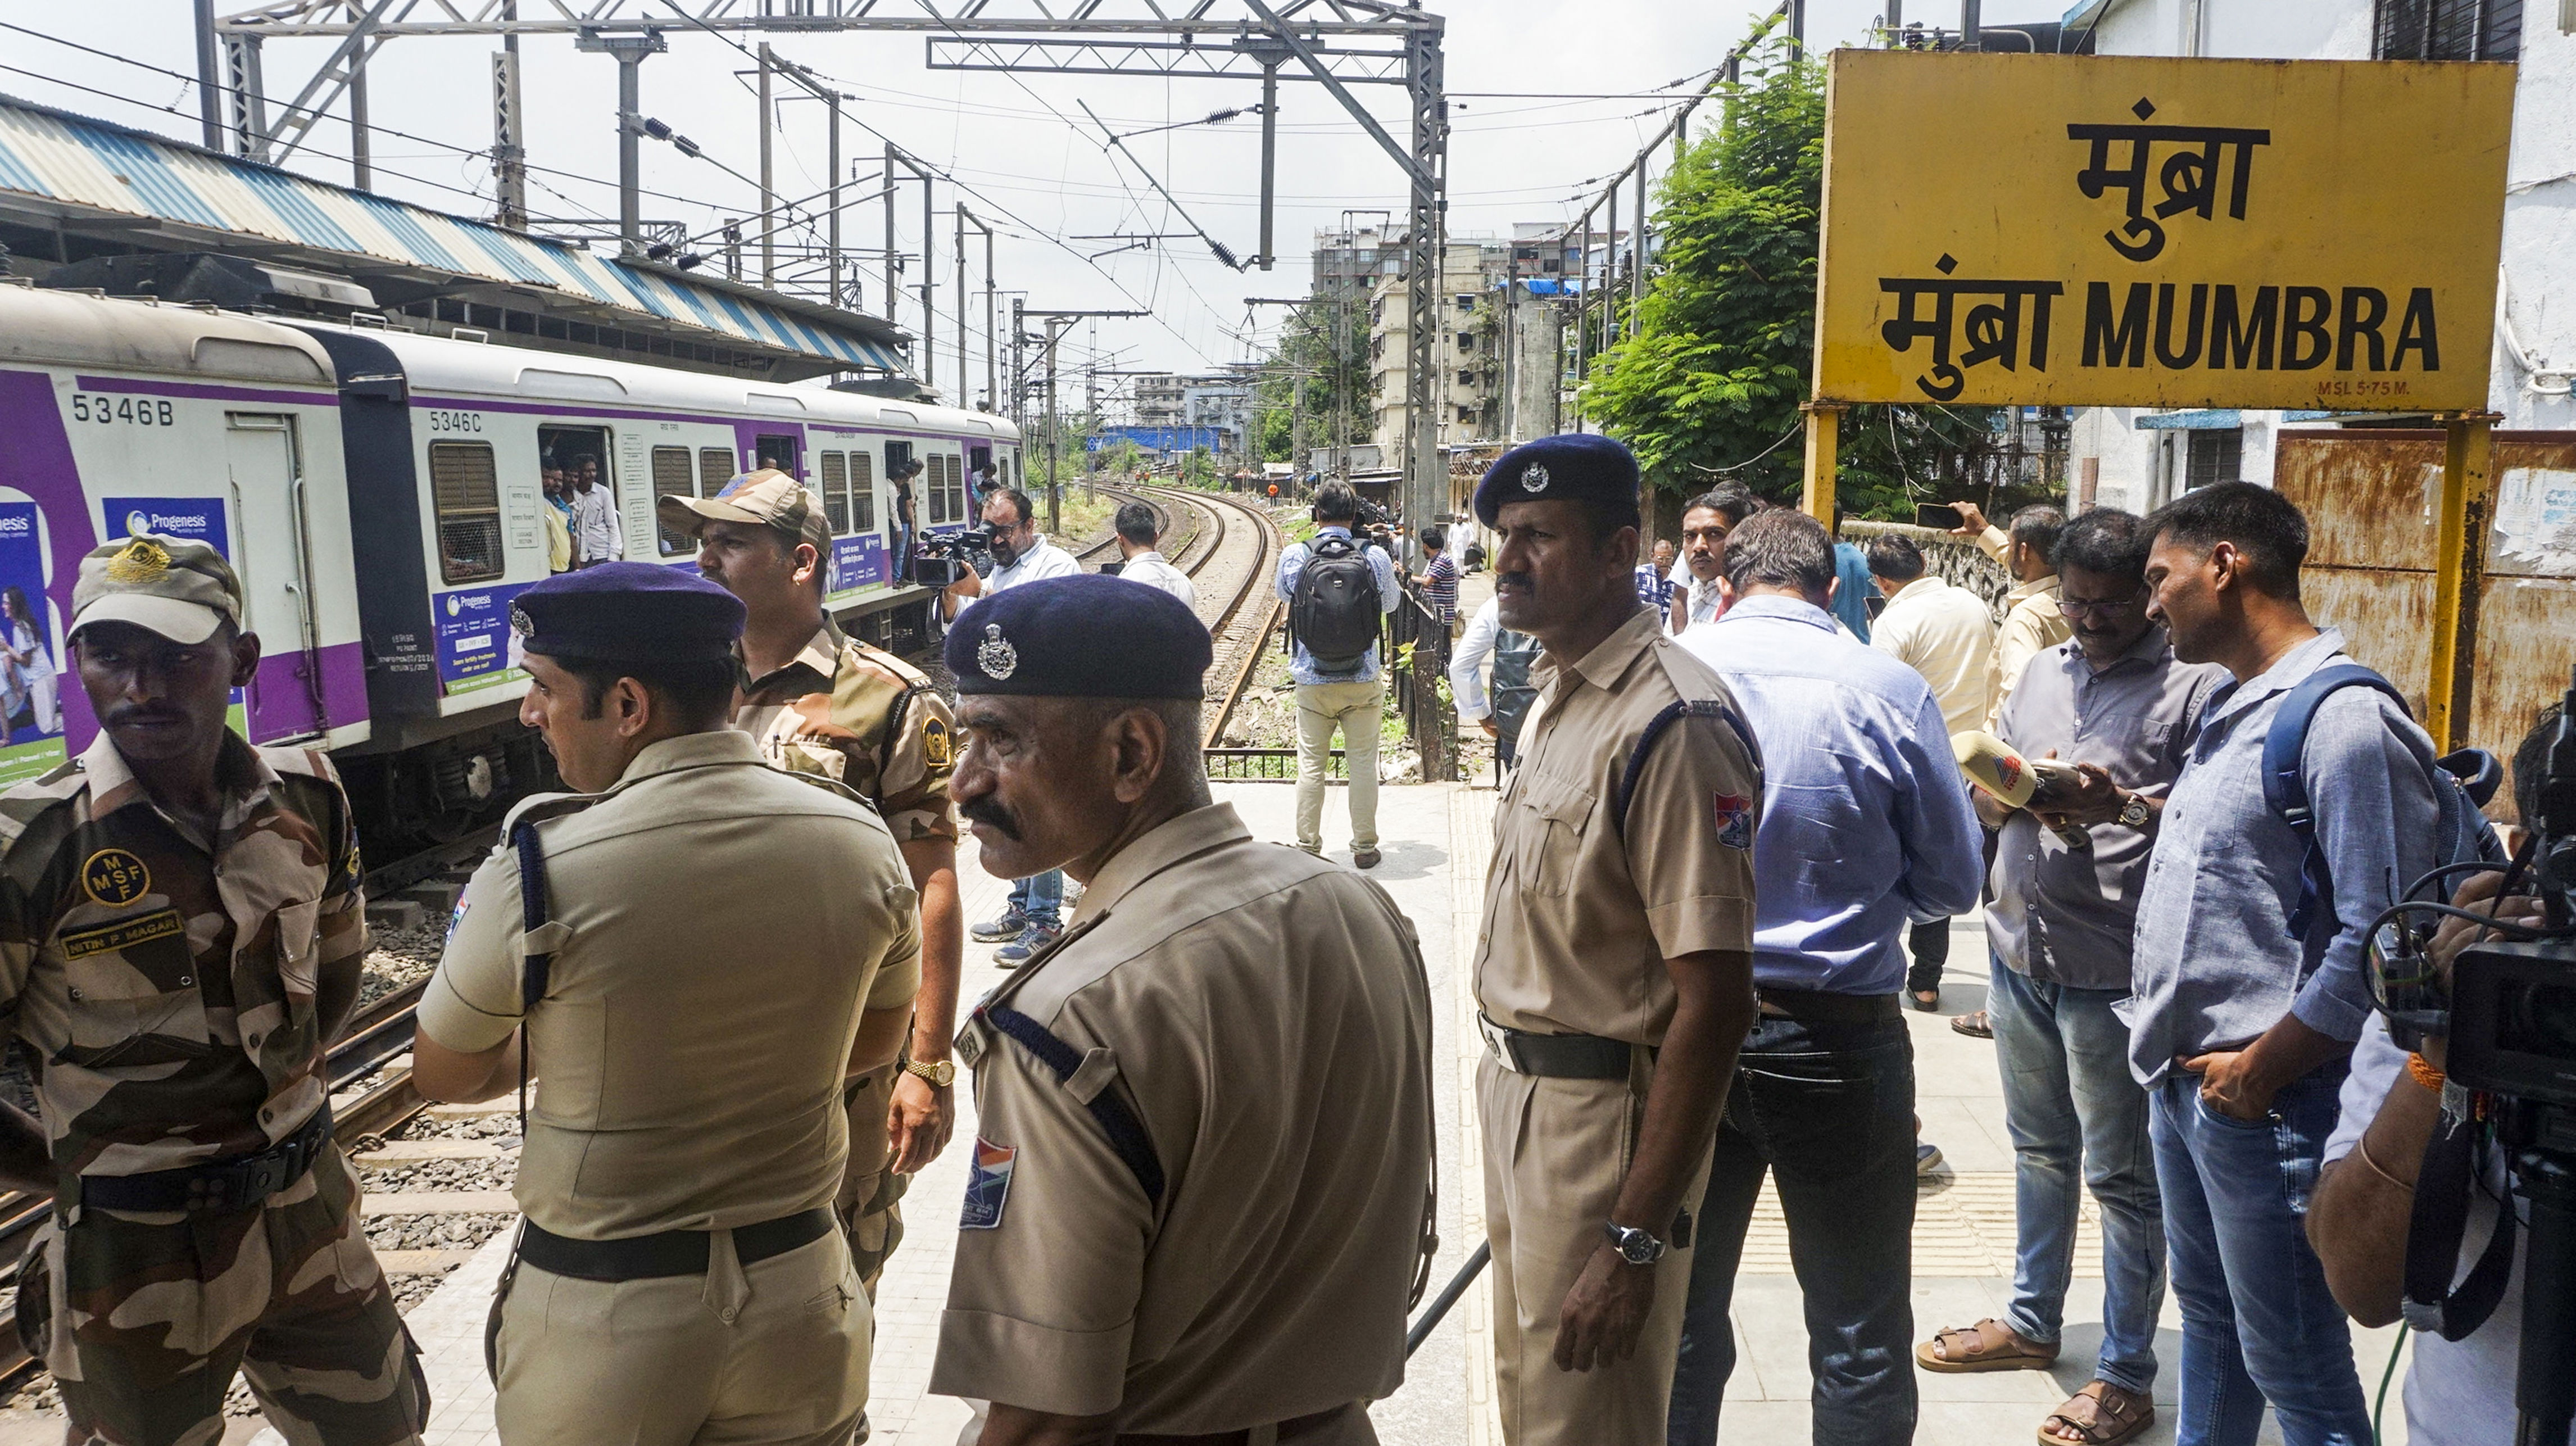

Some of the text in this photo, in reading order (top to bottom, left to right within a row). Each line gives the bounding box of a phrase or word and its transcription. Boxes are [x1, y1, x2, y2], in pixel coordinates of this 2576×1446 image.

[2066, 97, 2271, 262] मुंब्रा
[1878, 252, 2065, 402] मुंब्रा
[2081, 281, 2440, 372] MUMBRA
[2318, 381, 2352, 395] MSL
[72, 394, 173, 427] 5346B
[430, 411, 482, 432] 5346C
[151, 513, 206, 531] Progenesis
[460, 593, 492, 609] Progenesis
[69, 937, 106, 954] NITIN
[124, 919, 176, 941] MAGAR
